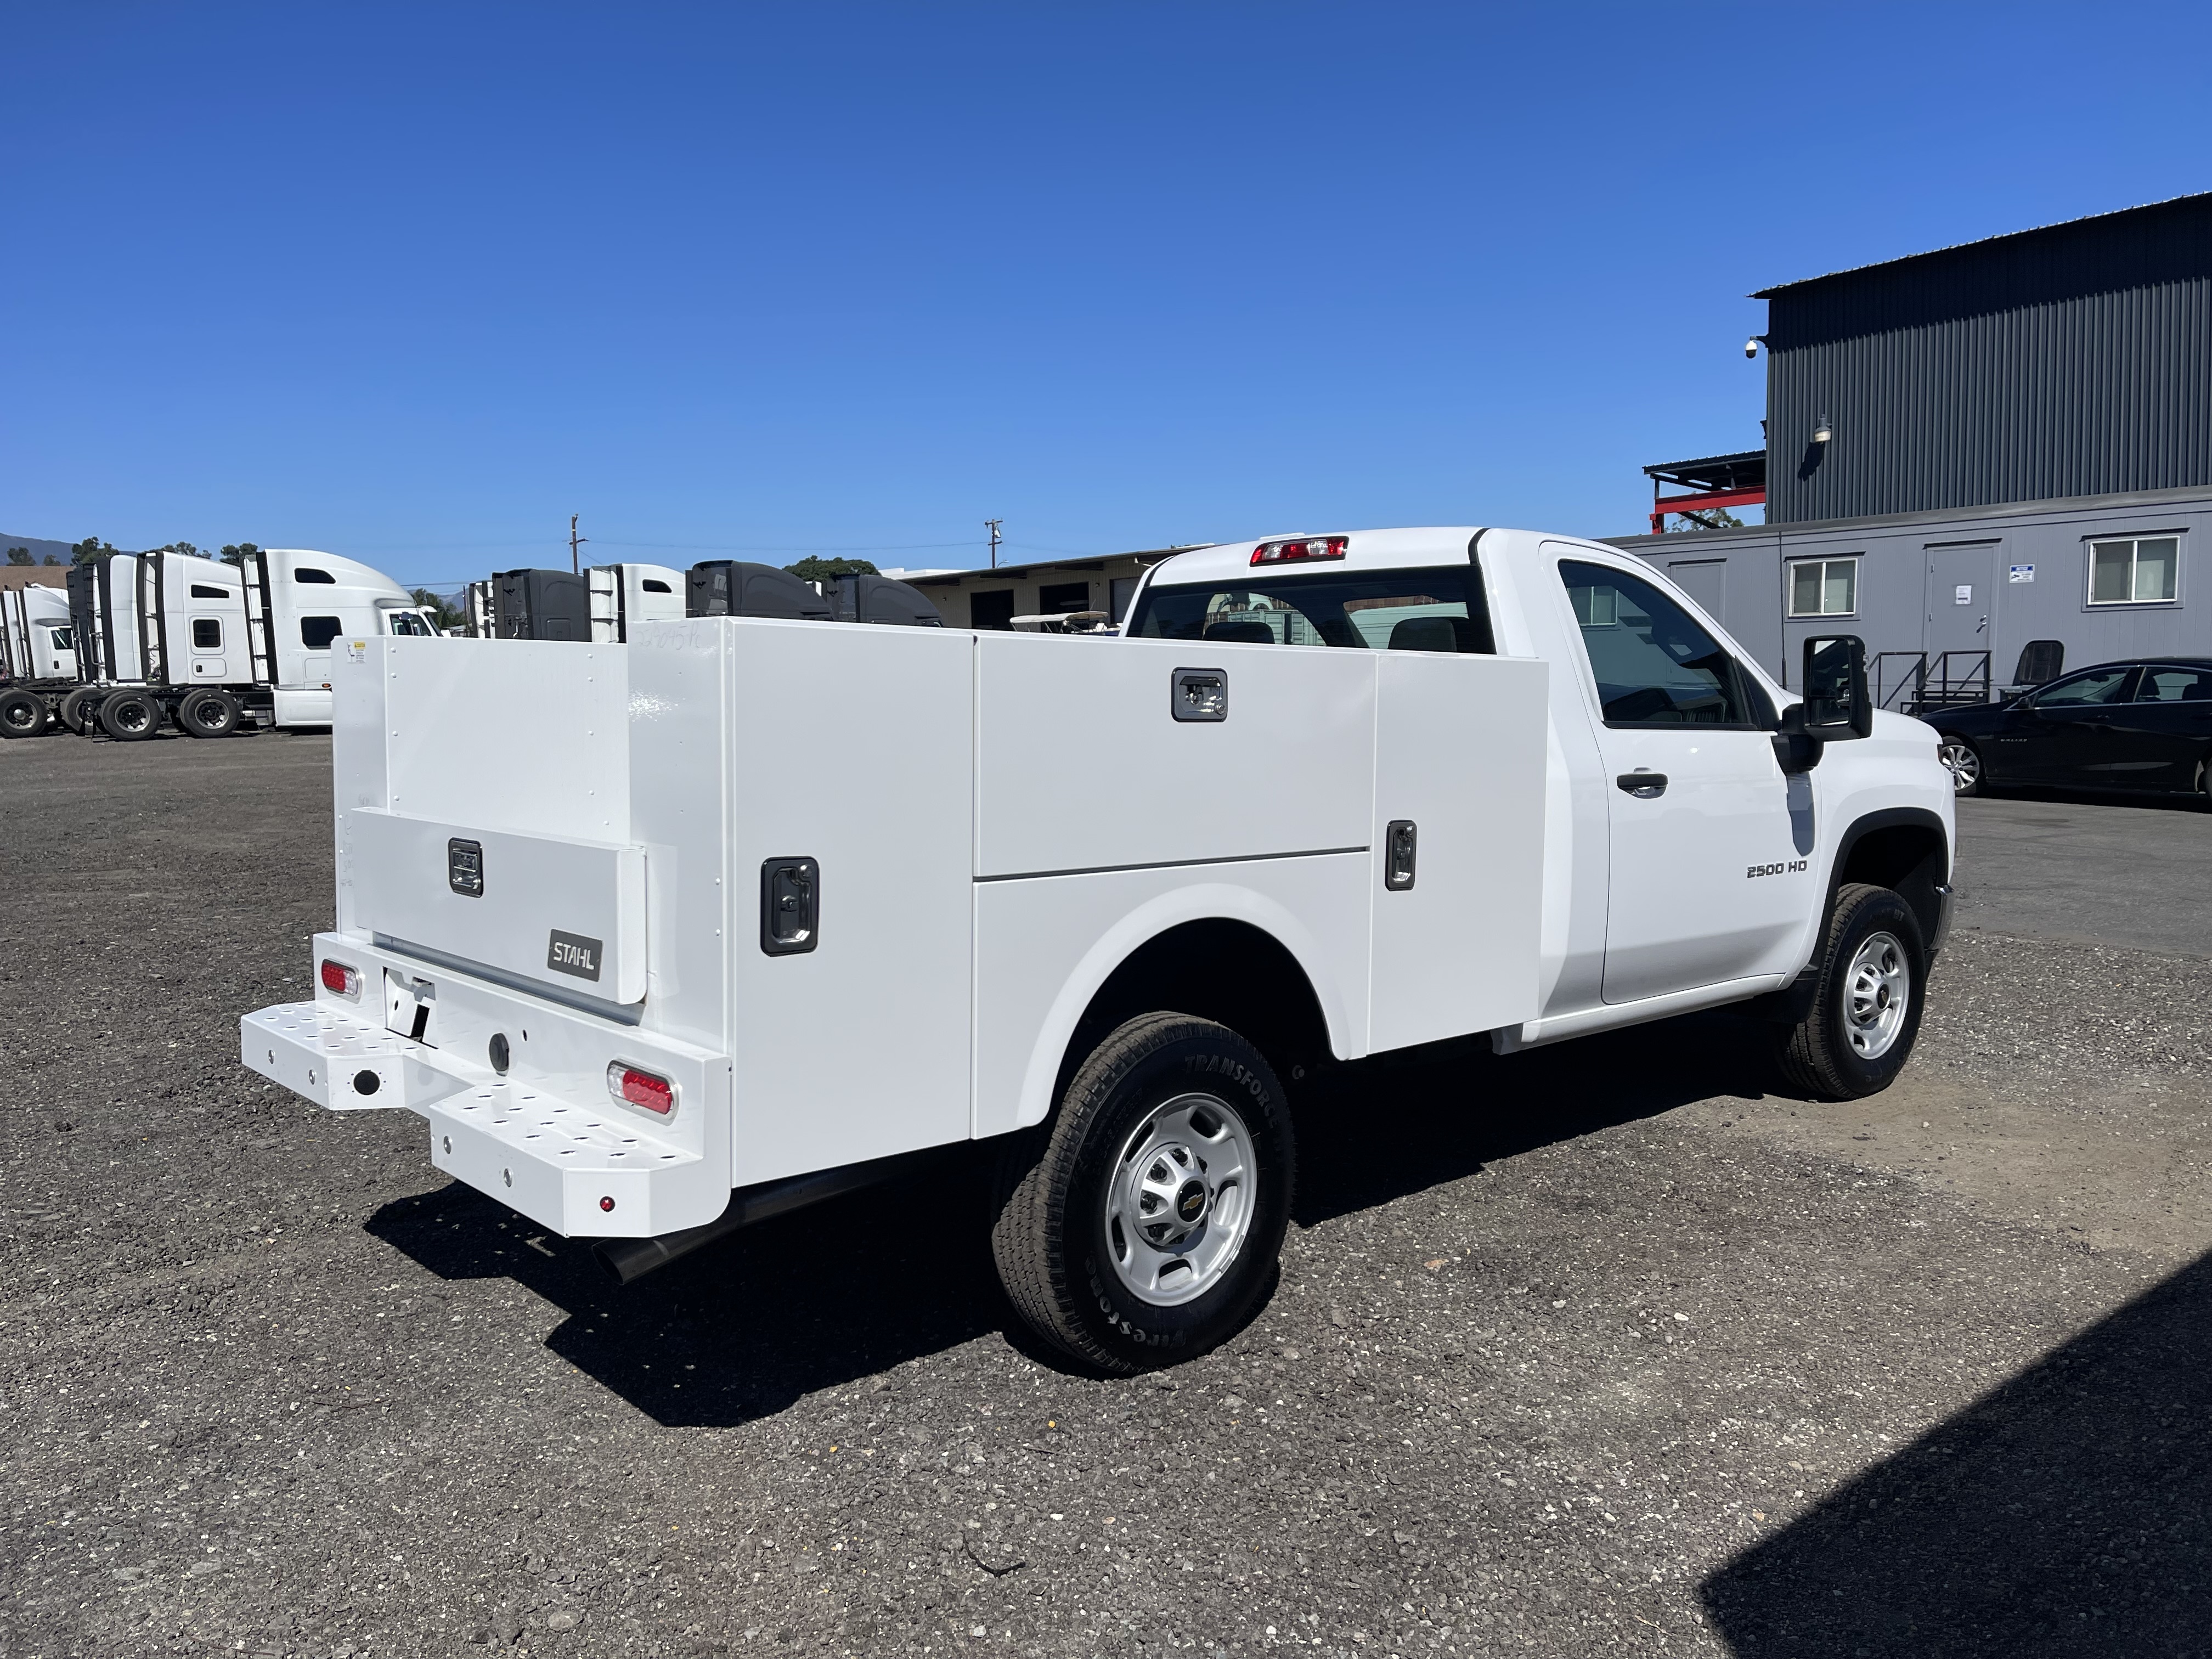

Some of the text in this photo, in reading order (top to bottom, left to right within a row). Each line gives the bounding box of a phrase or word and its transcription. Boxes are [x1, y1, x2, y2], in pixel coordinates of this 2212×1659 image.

[1747, 860, 1808, 878] 2500 HD
[553, 941, 595, 970] STAHL
[1184, 1053, 1279, 1129] TRANSFORCE
[1084, 1253, 1187, 1348] Firestone
